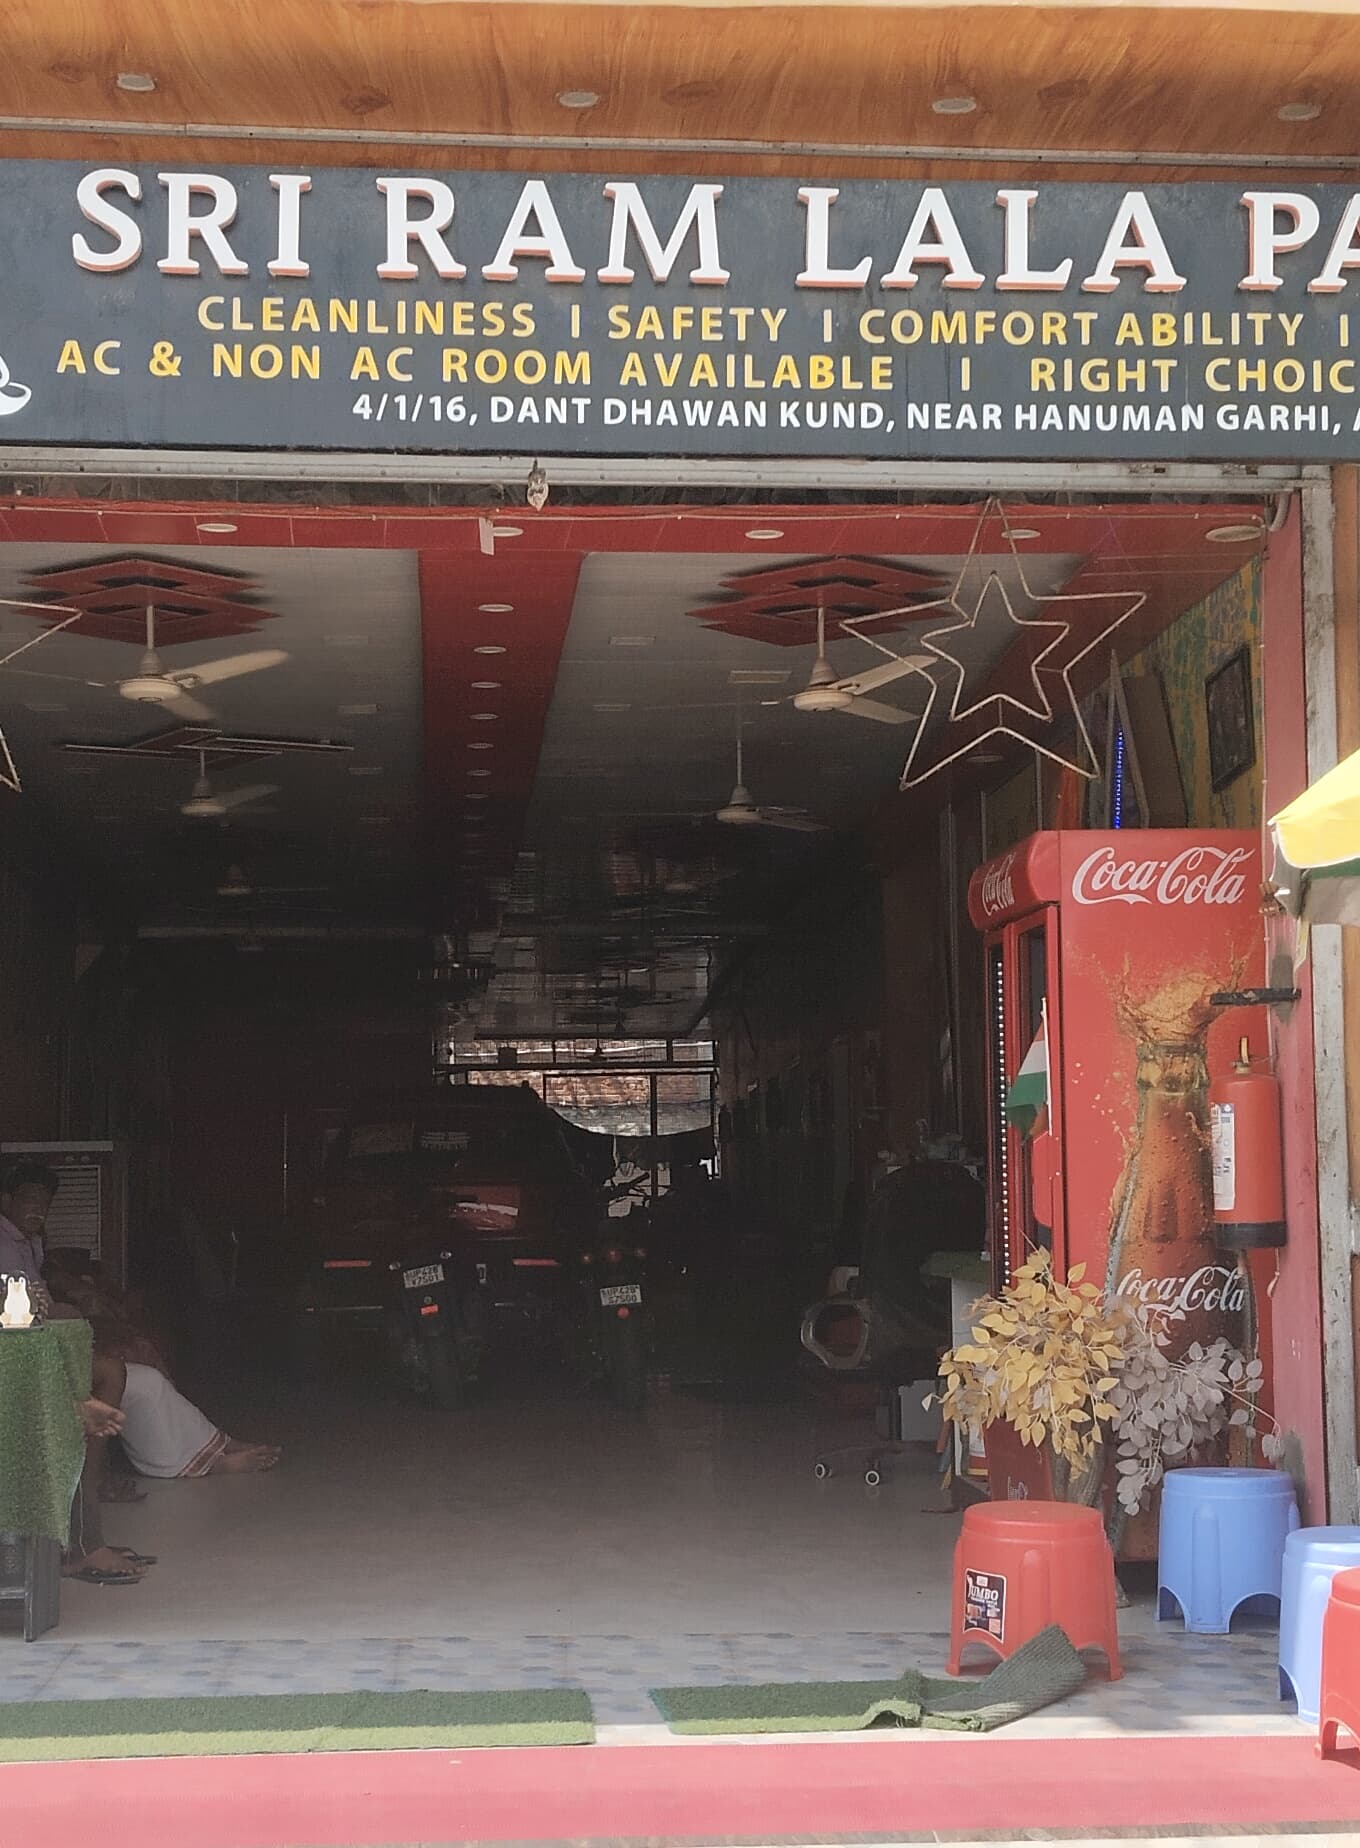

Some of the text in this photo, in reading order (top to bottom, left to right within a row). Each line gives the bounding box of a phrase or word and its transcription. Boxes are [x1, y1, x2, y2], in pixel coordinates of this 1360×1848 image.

[72, 168, 312, 277] SRI
[376, 176, 731, 286] RAM
[796, 186, 1187, 294] LALA
[198, 295, 537, 337] CLEANLINESS
[607, 304, 788, 343] SAFETY
[860, 308, 1096, 347] COMFORT
[1115, 312, 1304, 350] ABILITY
[56, 340, 120, 376] AC
[149, 340, 183, 377] &
[213, 342, 321, 381] NON
[350, 346, 414, 383] AC
[443, 347, 593, 386] ROOM
[620, 351, 894, 391] AVAILABLE
[1031, 357, 1179, 393] RIGHT
[353, 394, 478, 428] 4/1/16,
[490, 396, 592, 425] DANT
[604, 398, 769, 428] DHAWAN
[781, 399, 895, 434] KUND,
[907, 401, 1003, 431] NEAR
[1014, 402, 1205, 432] HANUMAN
[1217, 403, 1342, 438] GARHI,
[1072, 846, 1255, 905] Coca-Cola
